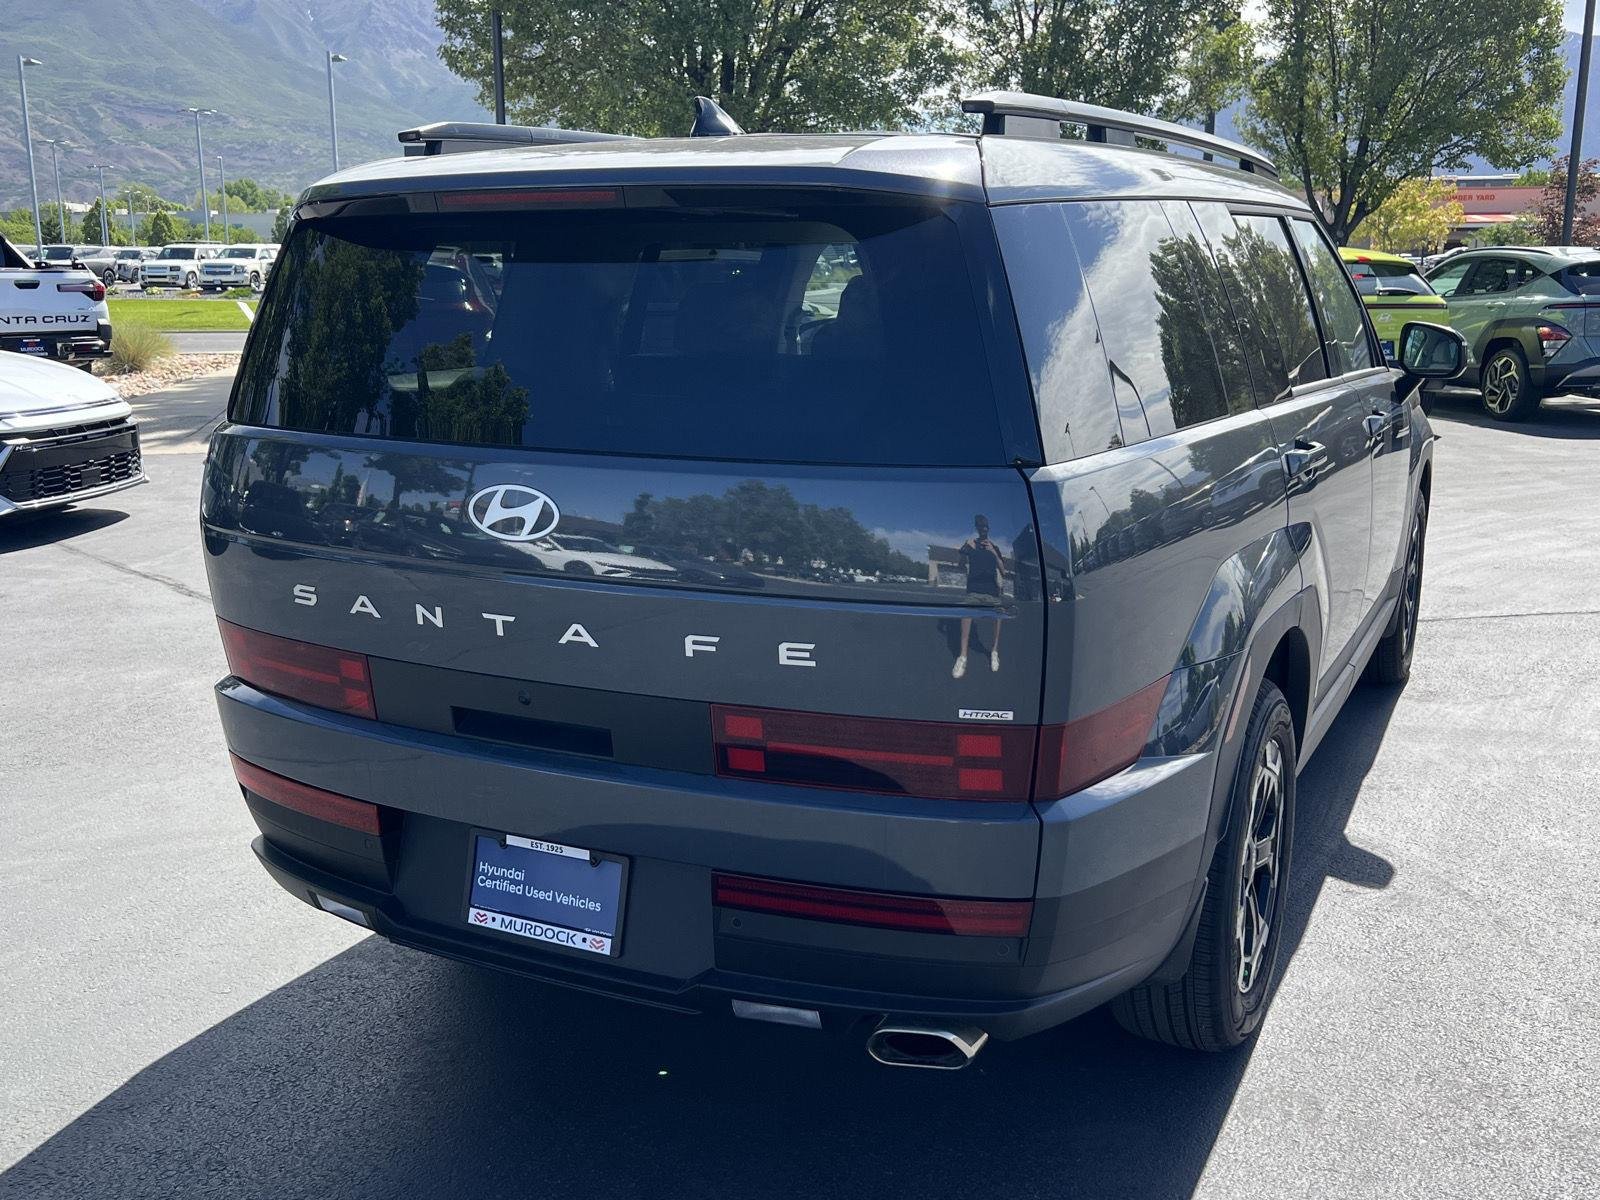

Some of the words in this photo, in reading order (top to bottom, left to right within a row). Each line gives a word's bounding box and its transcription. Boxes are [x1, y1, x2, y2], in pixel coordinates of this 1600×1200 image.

[42, 315, 90, 324] CRUZ
[292, 584, 599, 648] SANTA
[684, 634, 817, 668] FE
[962, 711, 1009, 719] HTRAC
[530, 840, 545, 850] EST.
[546, 843, 564, 854] 1925
[479, 861, 526, 881] Hyundai
[477, 876, 523, 895] Certified
[525, 886, 553, 902] Used
[555, 891, 602, 912] Vehicles
[500, 917, 577, 945] MURDOCK
